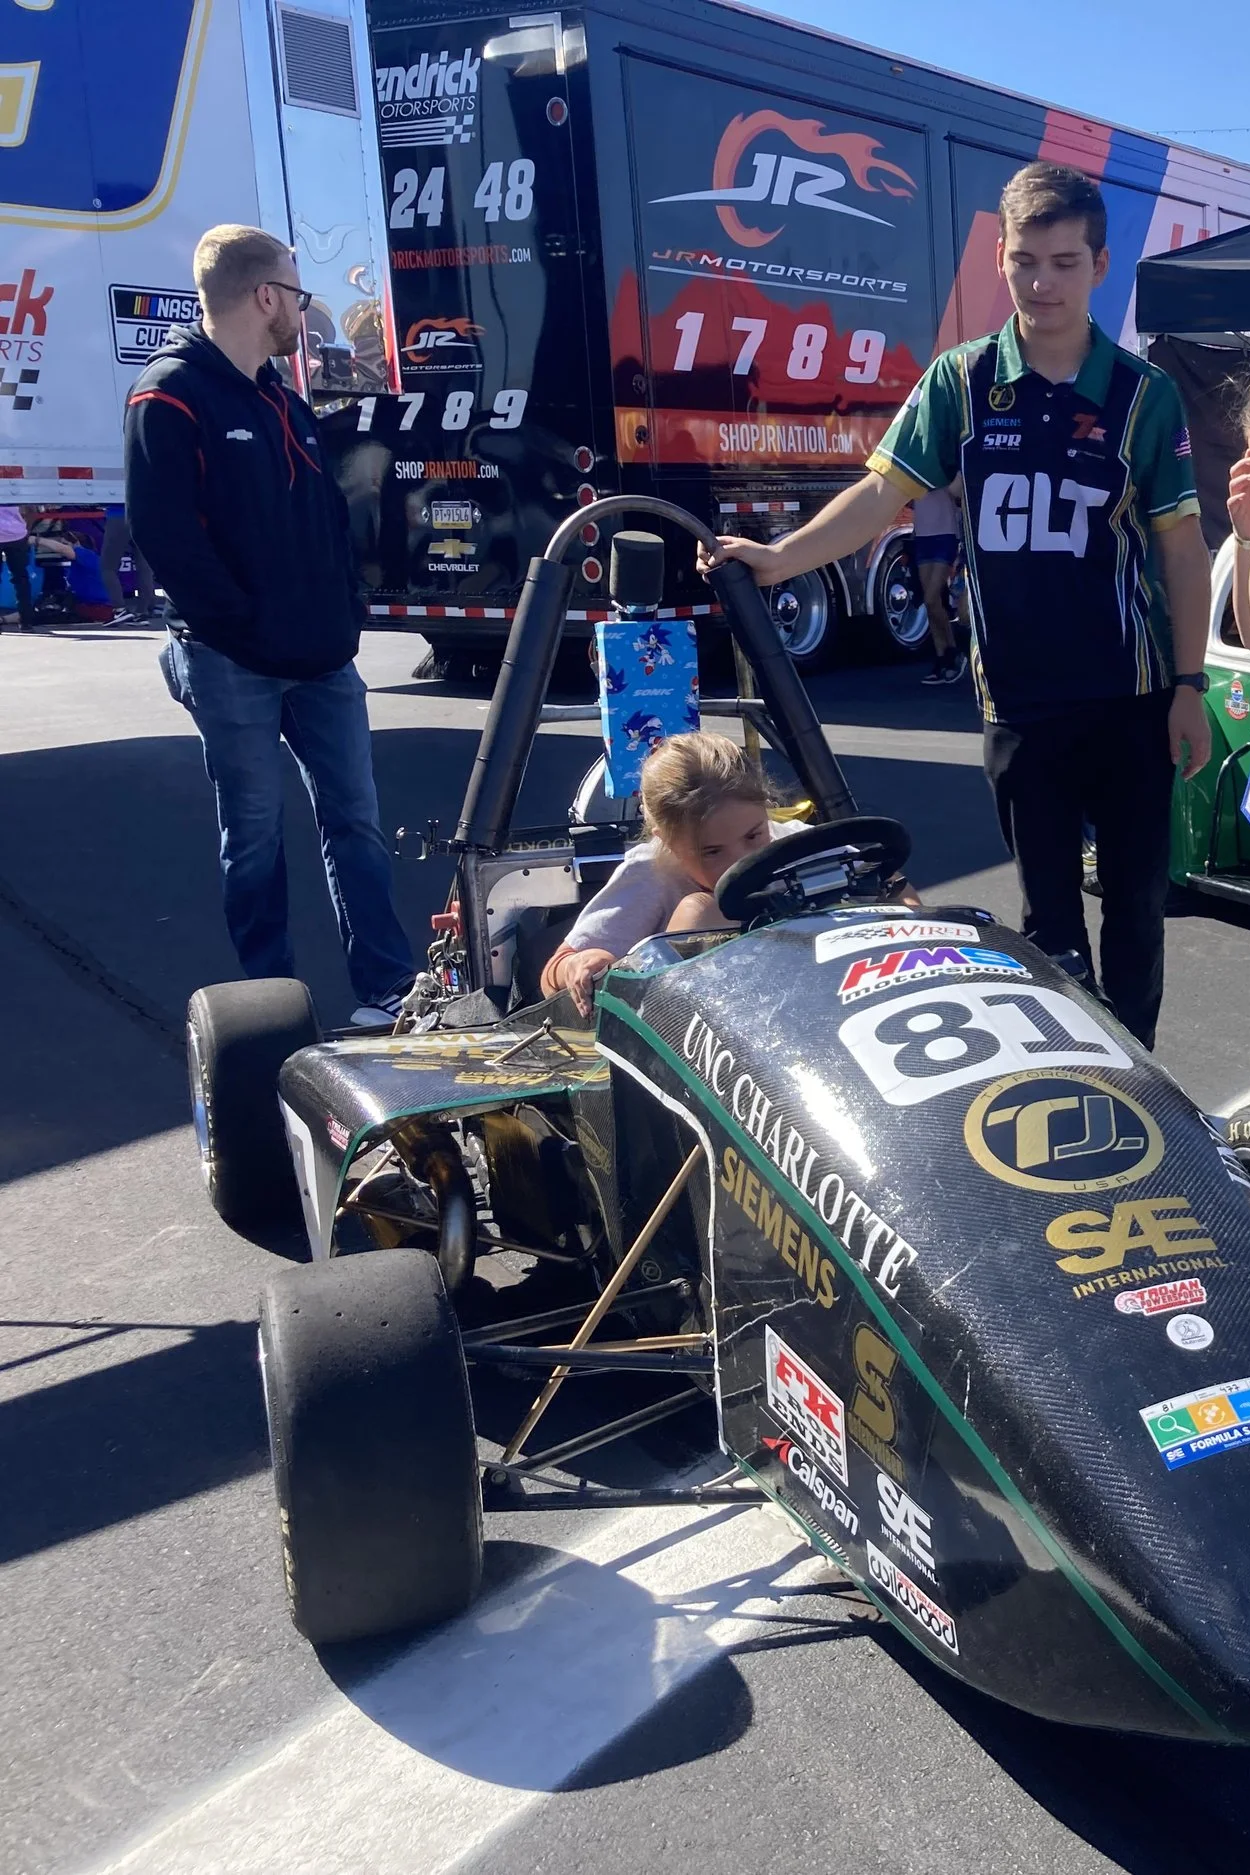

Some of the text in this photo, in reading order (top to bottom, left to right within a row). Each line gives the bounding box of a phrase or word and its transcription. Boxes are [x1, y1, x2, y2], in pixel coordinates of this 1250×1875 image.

[379, 95, 475, 118] OTORSPORTS
[390, 158, 535, 228] 24 48
[157, 298, 203, 320] NASC
[673, 312, 887, 384] 1 7 8 9
[357, 389, 528, 432] 1 7 8 9
[982, 433, 1022, 447] SPR
[977, 472, 1111, 558] CLT
[428, 563, 480, 572] CHEVROLET
[632, 687, 675, 697] SONIC
[887, 924, 973, 939] WIRED
[841, 948, 1026, 993] HMS
[844, 964, 1031, 1002] motorsport
[683, 1012, 734, 1096] UNC
[875, 994, 1111, 1079] 81
[1013, 1071, 1097, 1085] FORGED
[732, 1073, 918, 1298] CHARLOTTE
[721, 1146, 837, 1309] SIEMENS
[1046, 1196, 1218, 1275] SAE
[1072, 1256, 1228, 1299] INTERNATIONAL
[1136, 1280, 1199, 1299] TROJAN
[776, 1351, 840, 1438] FK
[786, 1391, 842, 1456] ROD
[1162, 1402, 1174, 1413] 81
[772, 1393, 843, 1477] ENDS
[1190, 1427, 1242, 1453] FORMULA
[788, 1446, 859, 1535] Calspan
[877, 1472, 936, 1569] SAE
[880, 1524, 939, 1586] INTERNATIONAL
[870, 1555, 955, 1649] wilwood
